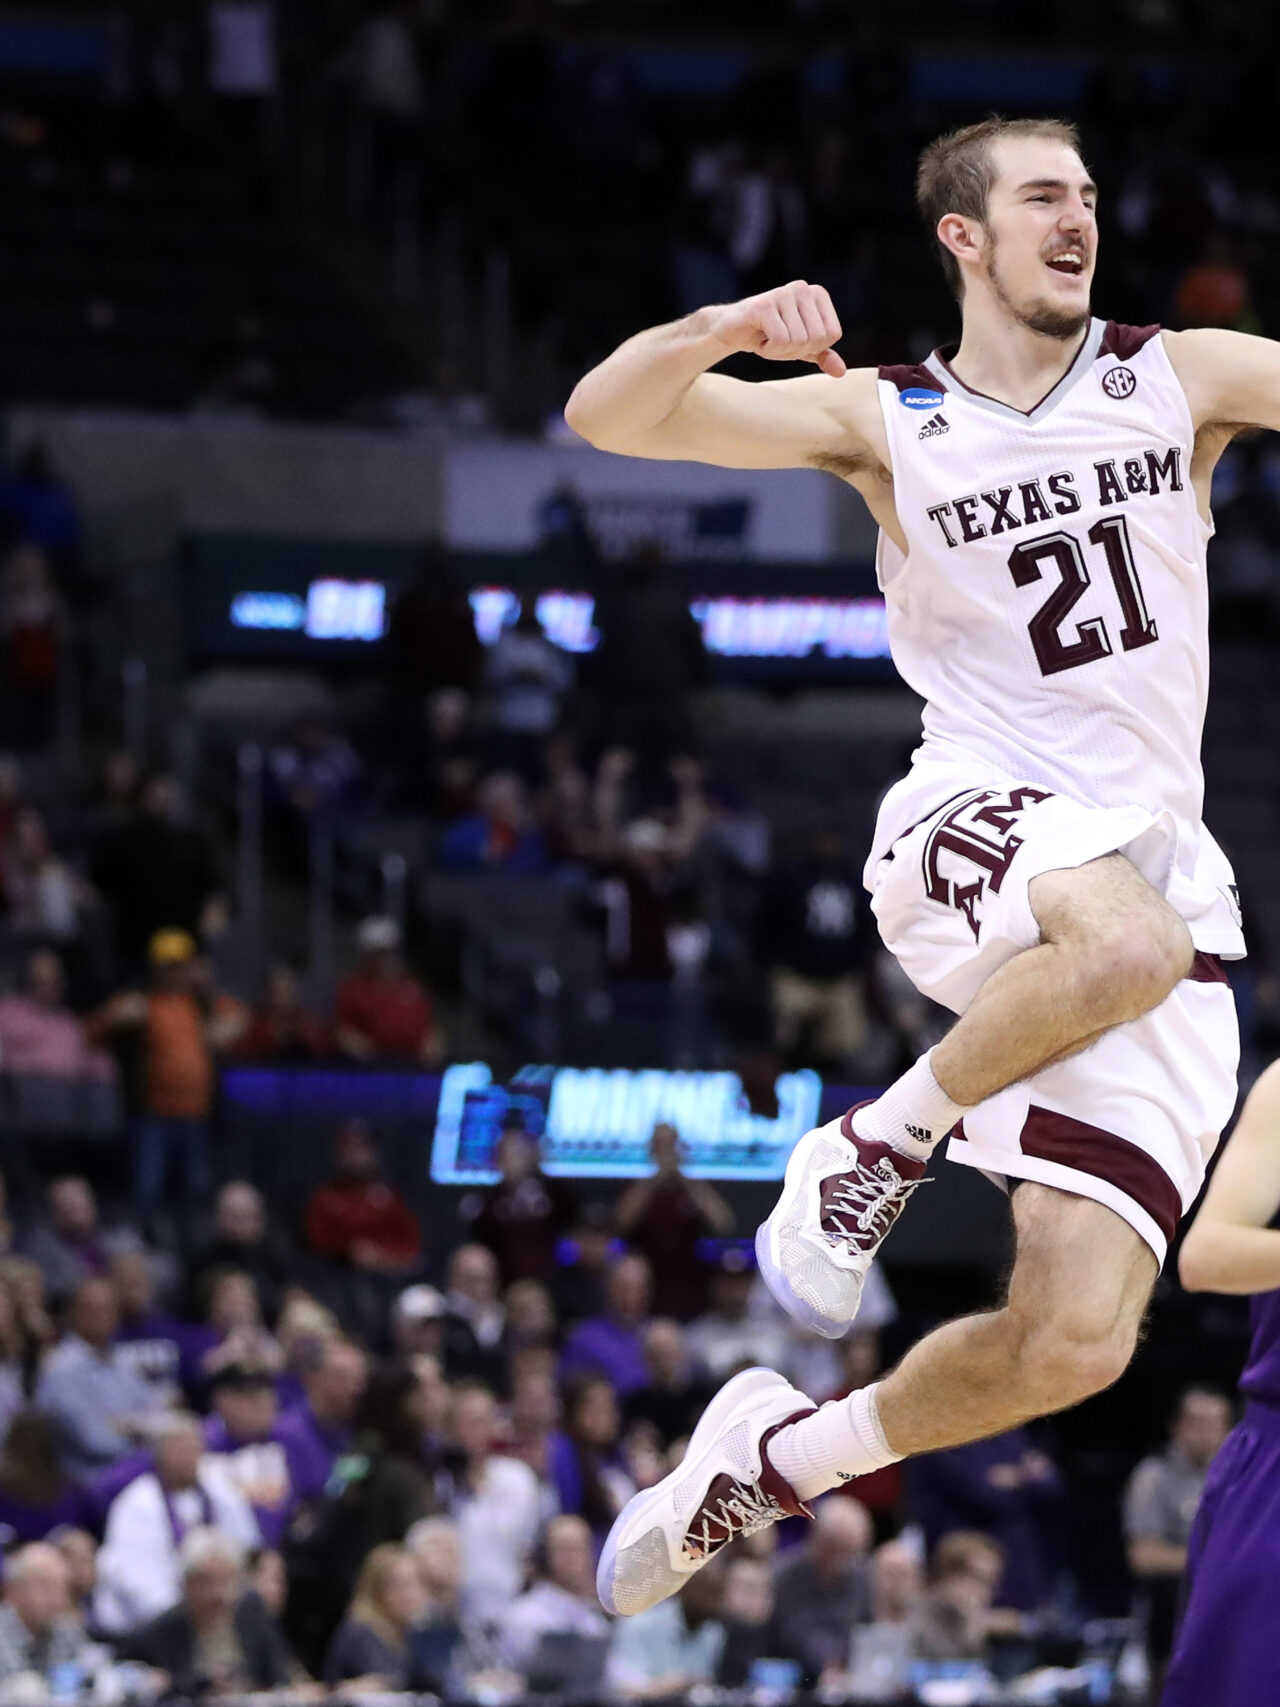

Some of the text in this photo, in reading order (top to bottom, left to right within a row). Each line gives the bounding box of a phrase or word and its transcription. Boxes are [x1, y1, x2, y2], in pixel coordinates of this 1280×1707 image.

[1103, 367, 1136, 399] SEC
[904, 396, 943, 405] NCAA
[918, 425, 951, 440] adida
[926, 447, 1184, 548] TEXAS A&M
[1007, 513, 1159, 677] 21
